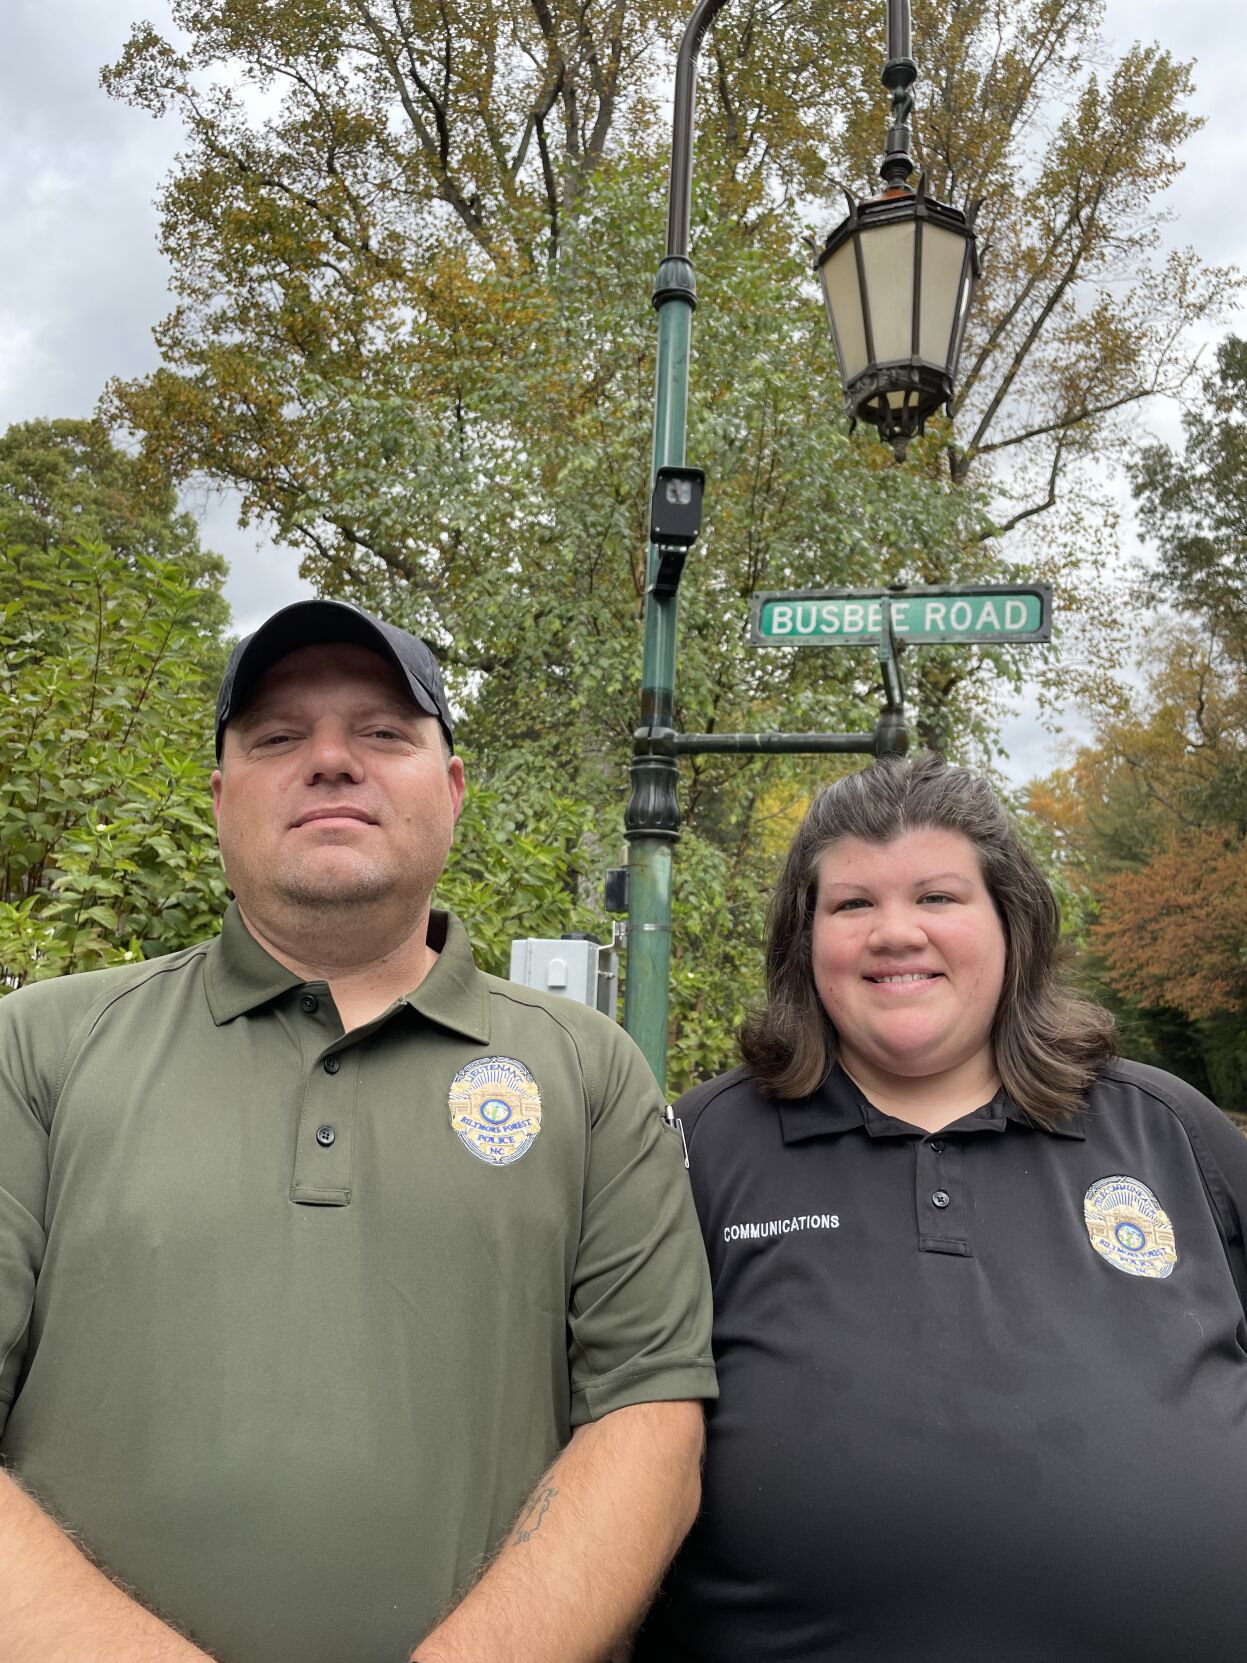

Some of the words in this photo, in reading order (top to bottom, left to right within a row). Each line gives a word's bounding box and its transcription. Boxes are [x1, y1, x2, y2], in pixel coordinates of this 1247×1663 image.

[771, 602, 909, 634] BUSBEE
[925, 600, 1027, 632] ROAD
[465, 1063, 523, 1084] LIEUTENANT
[460, 1116, 501, 1134] BILTMORE
[503, 1118, 532, 1133] FOREST
[476, 1133, 516, 1145] POLICE
[723, 1214, 840, 1243] COMMUNICATIONS
